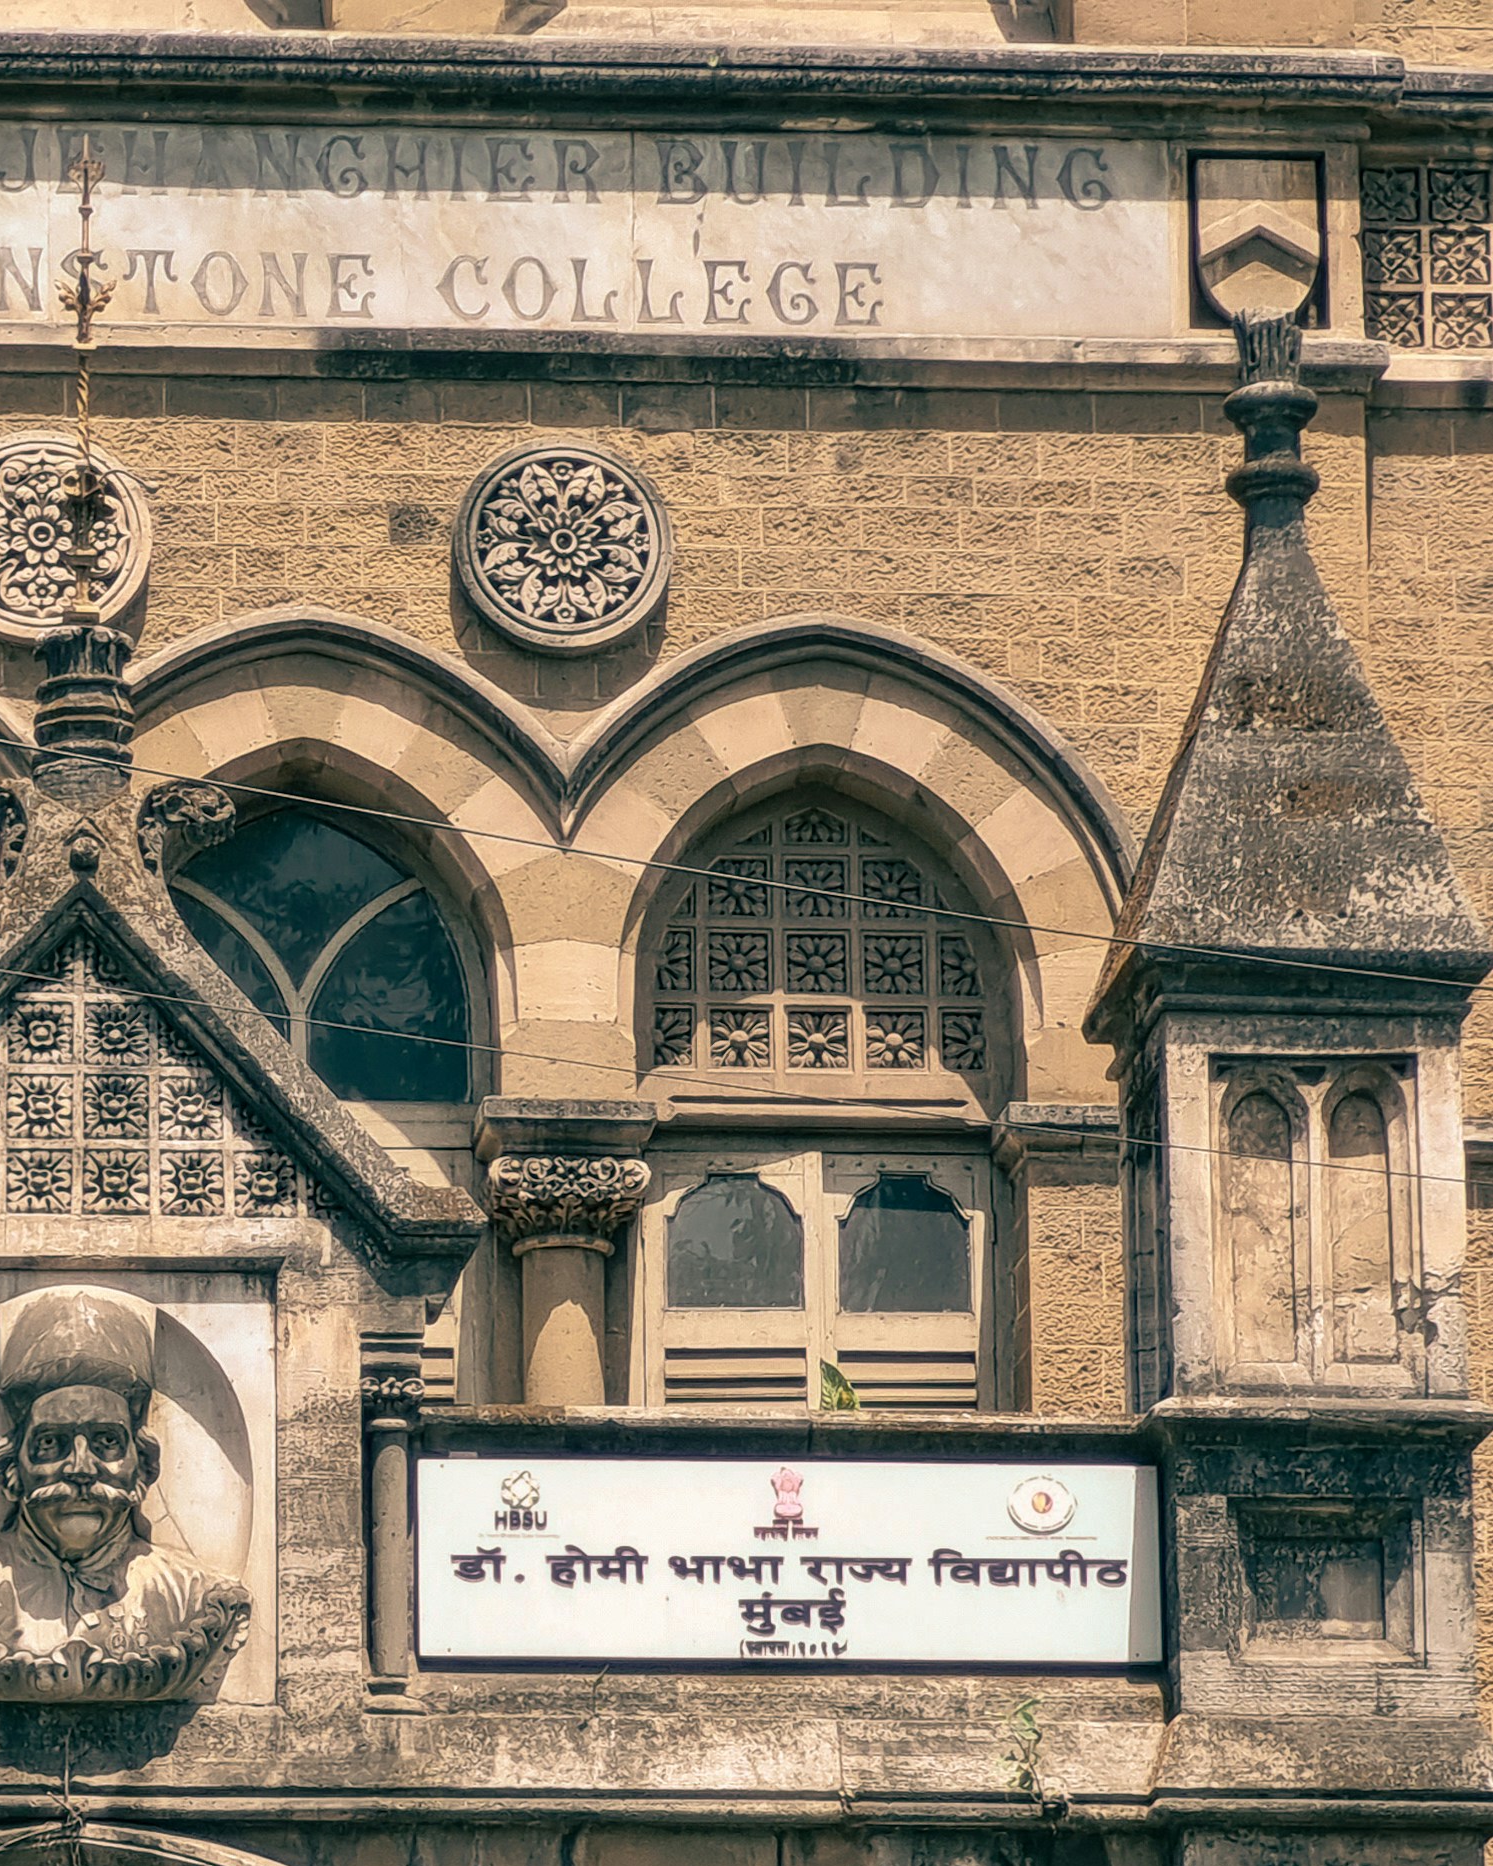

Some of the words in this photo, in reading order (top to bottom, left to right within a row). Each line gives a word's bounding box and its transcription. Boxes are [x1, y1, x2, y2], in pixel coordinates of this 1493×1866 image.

[653, 138, 1112, 212] BUILDING
[434, 253, 884, 327] COLLEGE
[494, 1509, 548, 1532] HBSU
[450, 1546, 526, 1583] डॉ.
[545, 1544, 649, 1588] होमी
[668, 1555, 784, 1585] भाभा
[799, 1556, 913, 1587] राज्य
[927, 1548, 1129, 1588] विद्यापीठ
[738, 1587, 847, 1636] मुंबई
